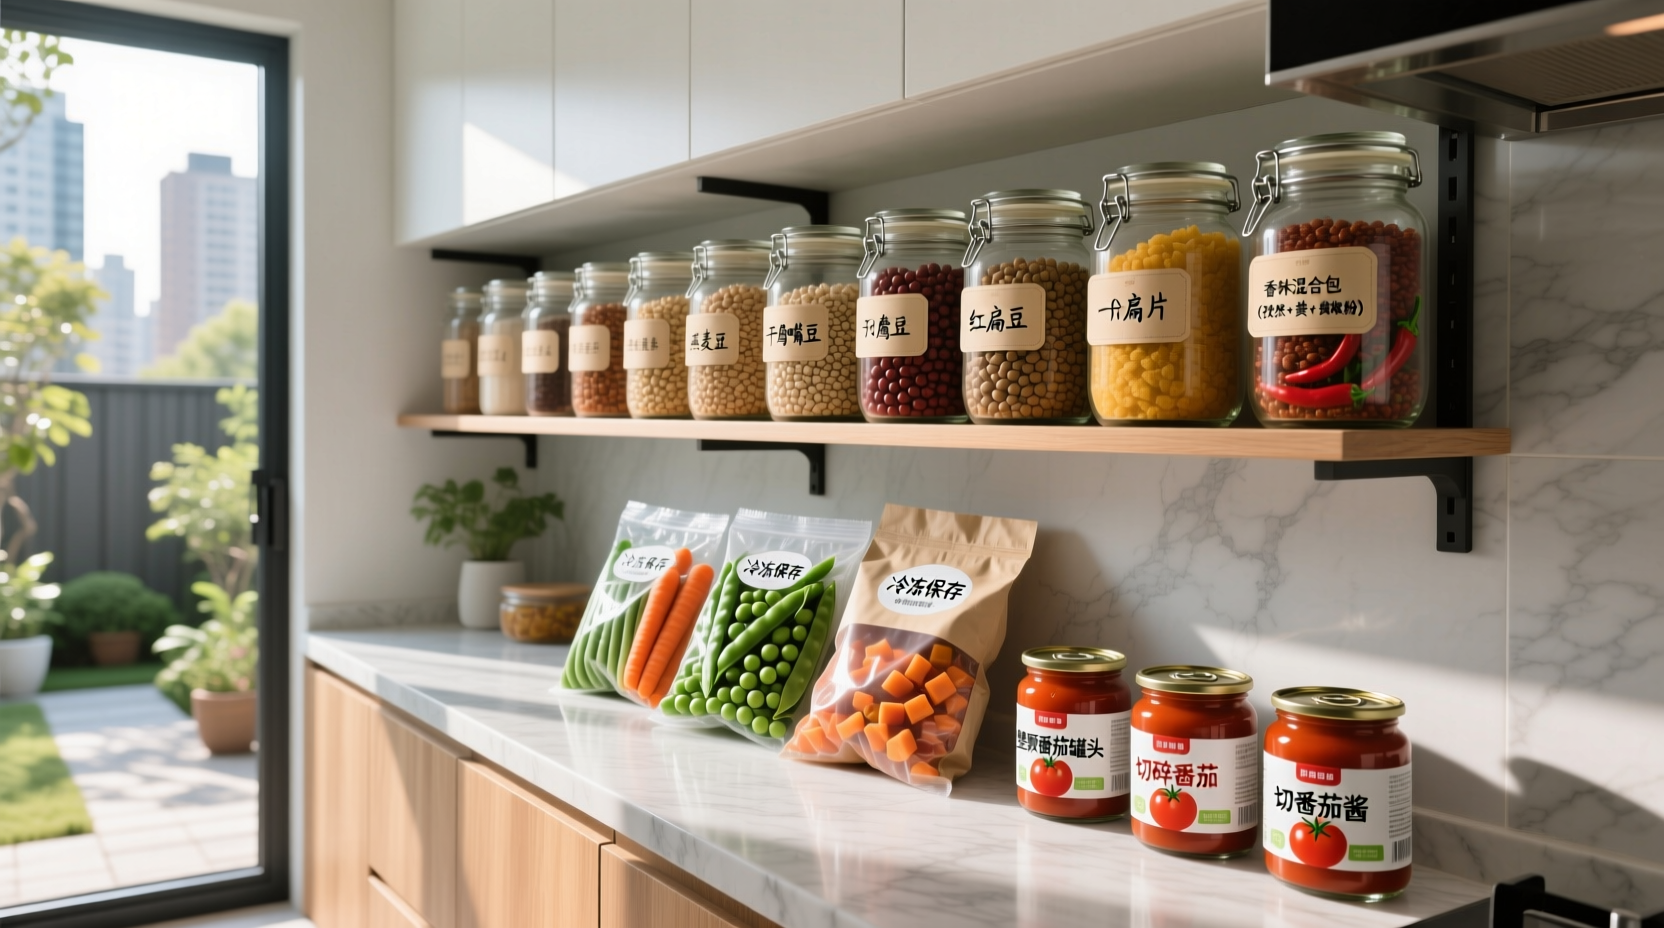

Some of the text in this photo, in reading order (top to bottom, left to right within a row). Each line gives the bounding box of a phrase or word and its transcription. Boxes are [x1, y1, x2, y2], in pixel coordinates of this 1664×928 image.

[969, 305, 1027, 333] 红扁豆
[743, 559, 804, 580] 冷冻保存
[886, 575, 966, 601] 冷冻保存
[1136, 756, 1218, 788] 切碎番茄
[1274, 785, 1369, 823] 切番茄酱
